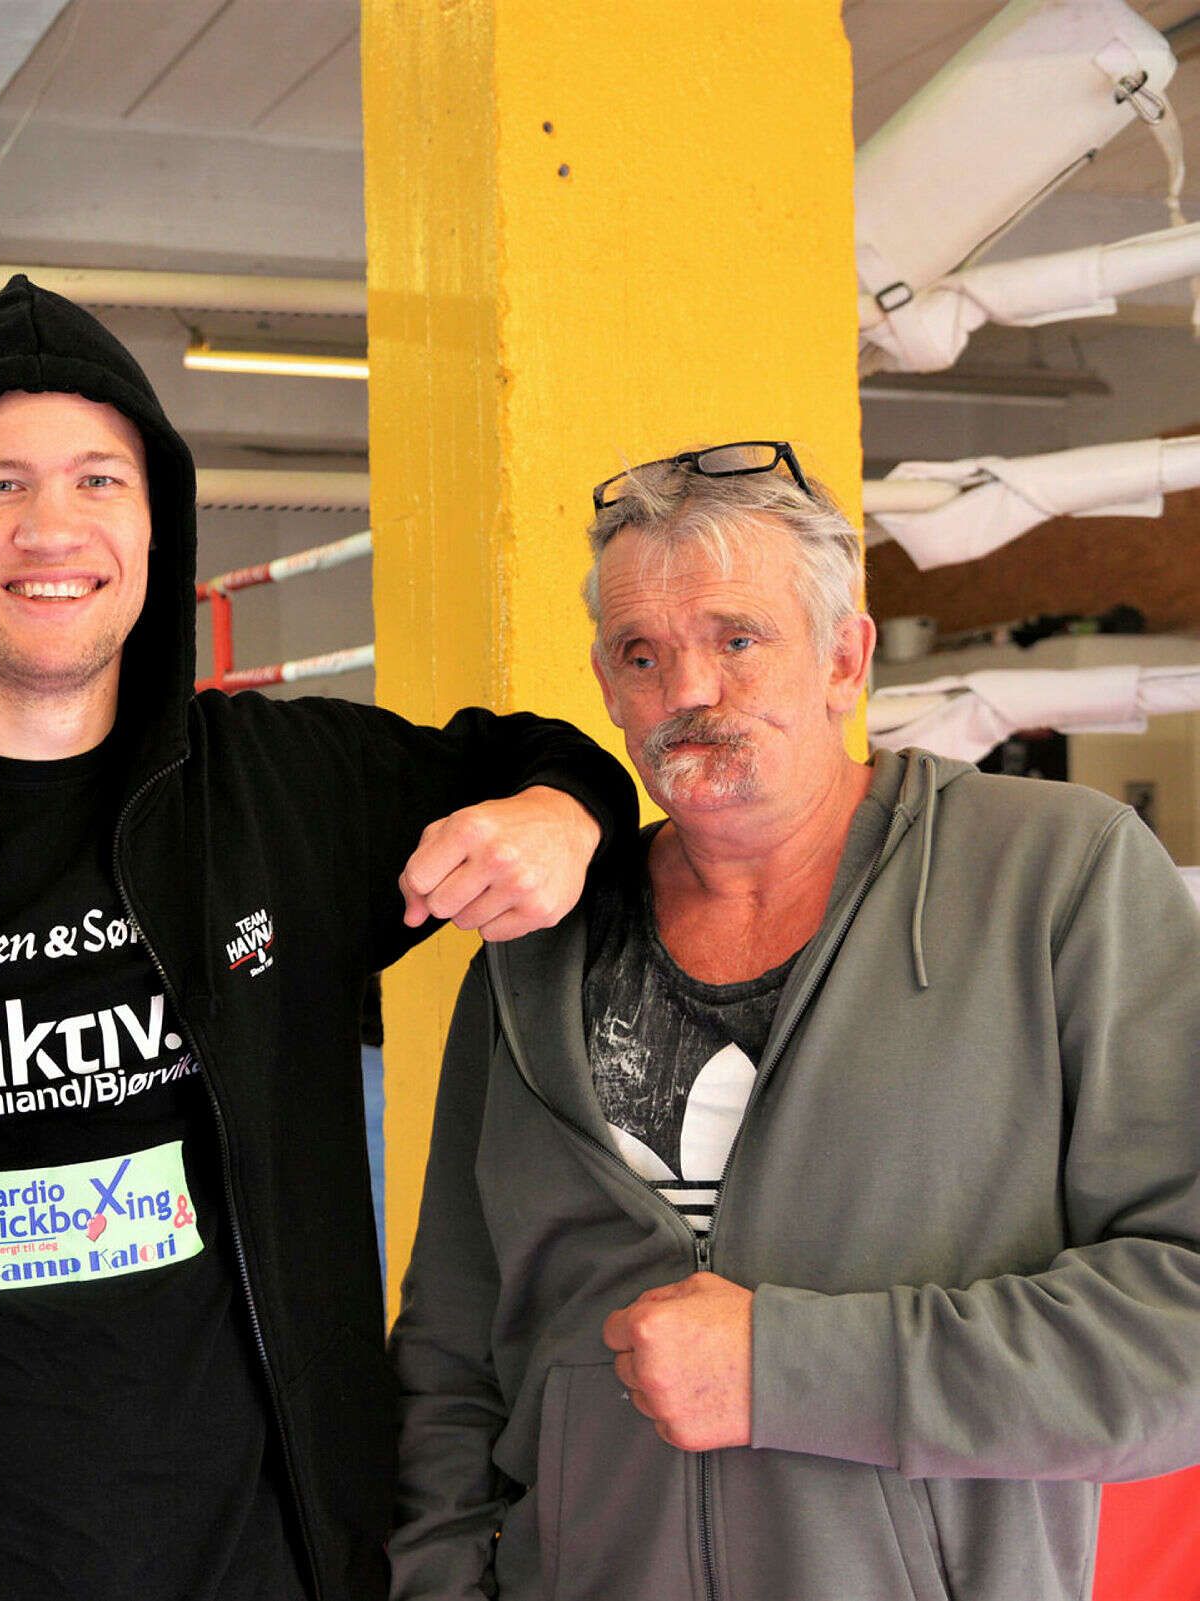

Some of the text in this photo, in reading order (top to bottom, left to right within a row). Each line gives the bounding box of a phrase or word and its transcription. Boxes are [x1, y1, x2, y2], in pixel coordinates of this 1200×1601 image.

[235, 908, 268, 935] TEAM
[44, 925, 78, 958] &
[88, 1233, 177, 1272] Kalori
